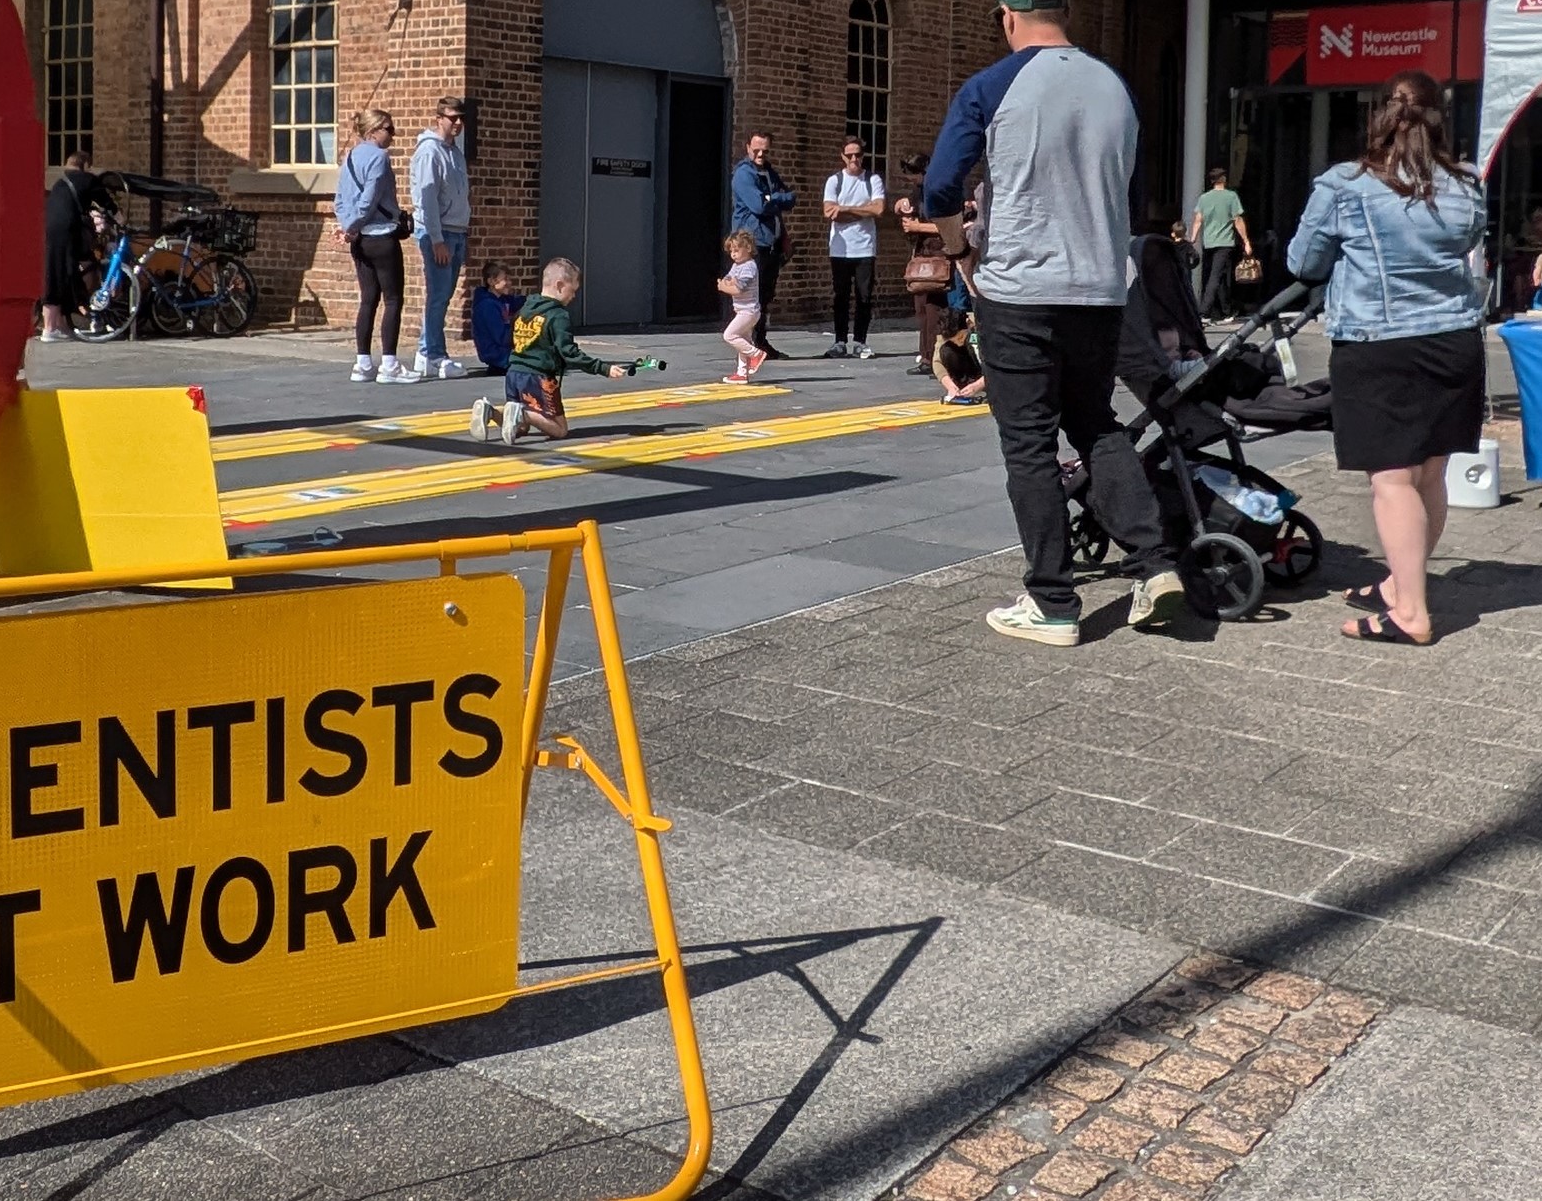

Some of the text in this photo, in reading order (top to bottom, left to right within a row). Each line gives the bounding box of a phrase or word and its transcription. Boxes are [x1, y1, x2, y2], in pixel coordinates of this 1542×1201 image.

[1361, 27, 1438, 43] Newcastle
[1361, 43, 1422, 56] Museum
[98, 830, 437, 984] WORK
